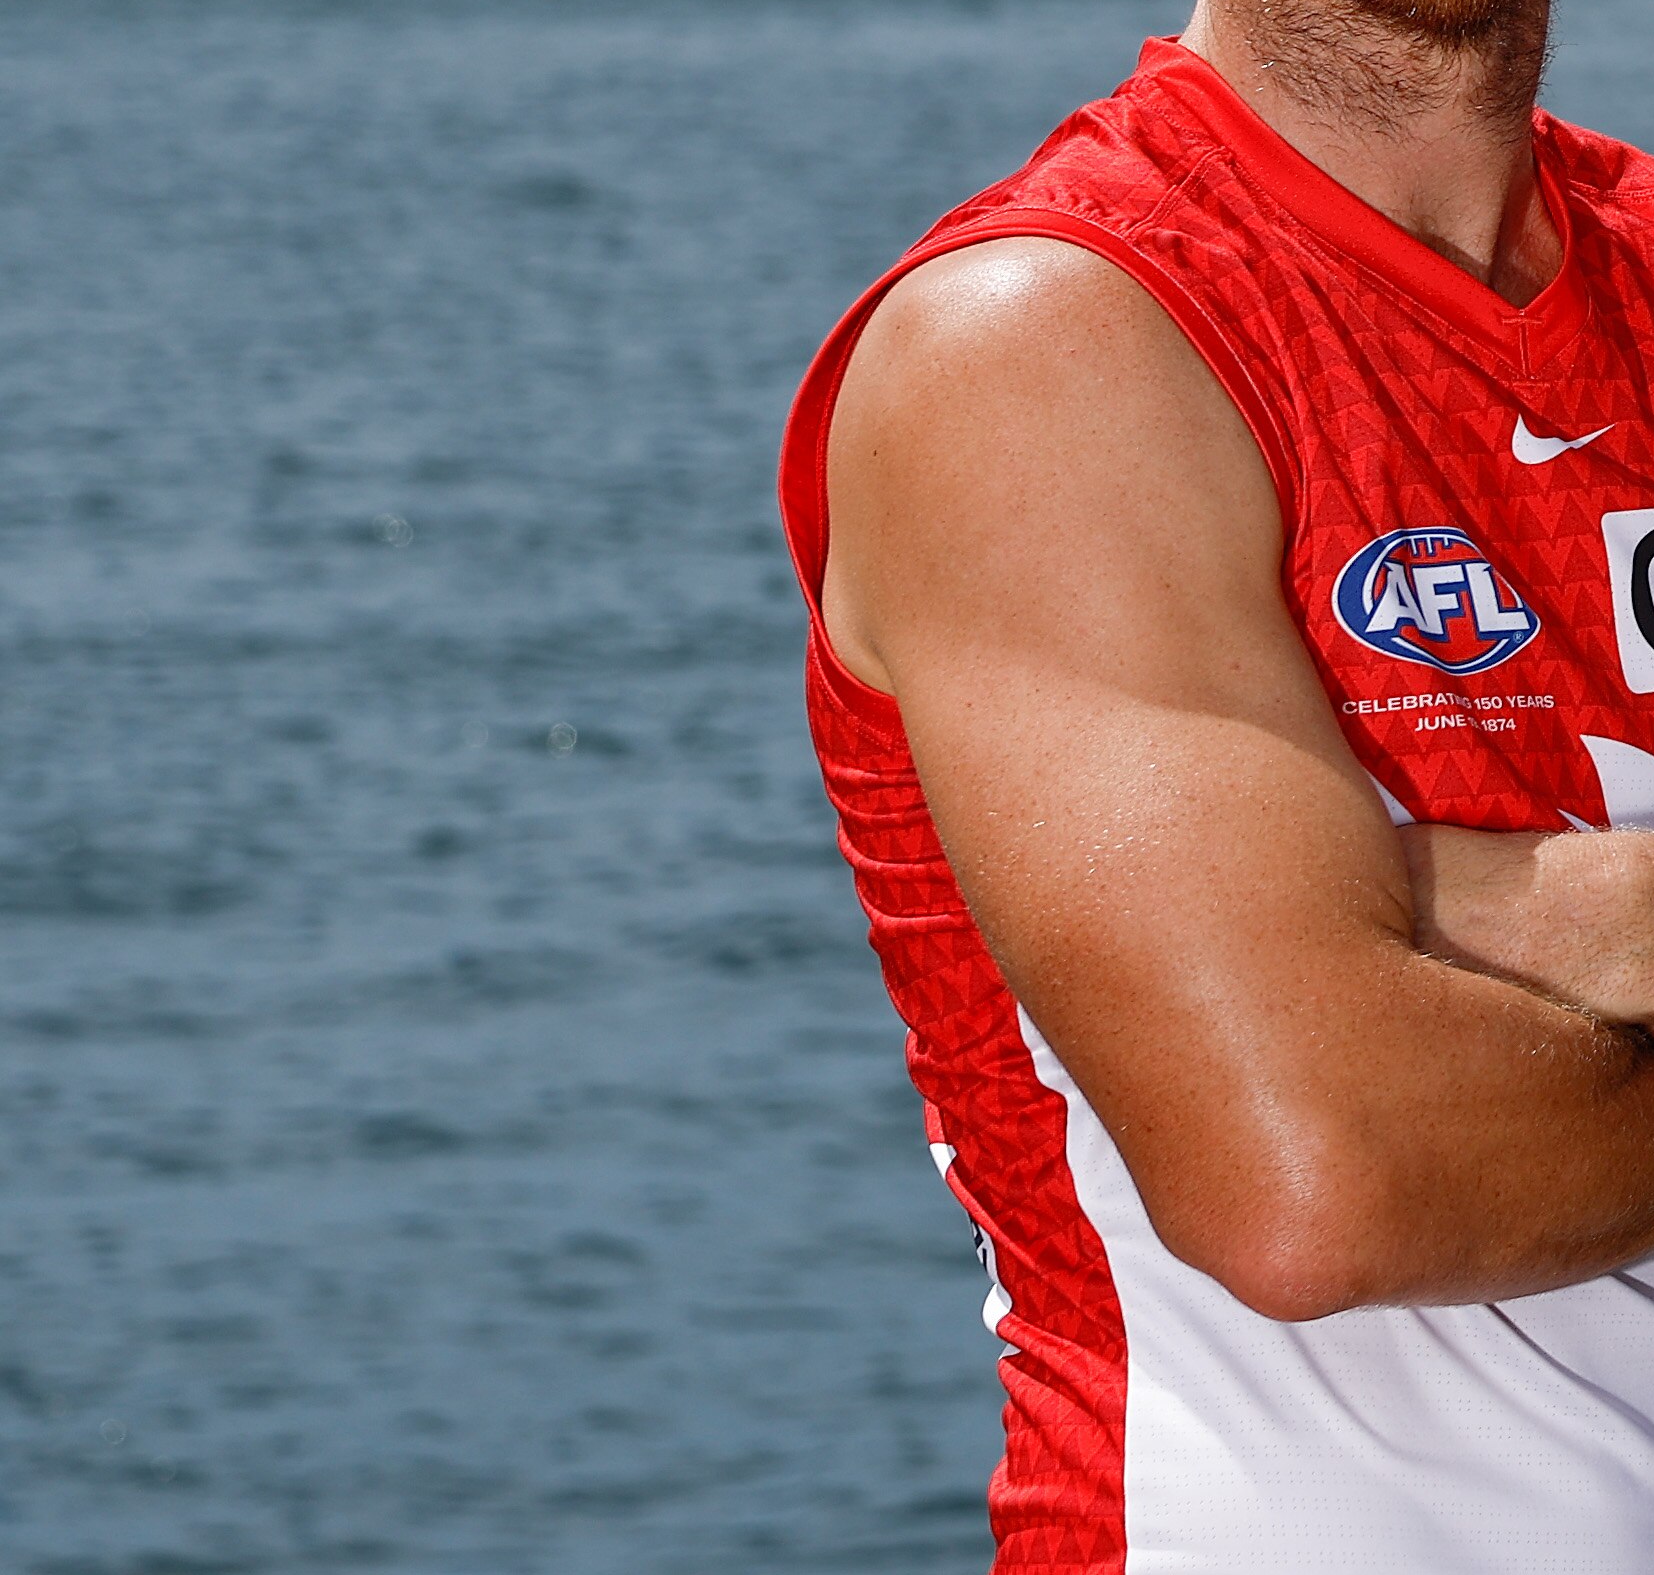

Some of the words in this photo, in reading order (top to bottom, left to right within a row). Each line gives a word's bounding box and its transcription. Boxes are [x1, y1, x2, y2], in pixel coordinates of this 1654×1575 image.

[1365, 561, 1530, 635] AFL
[1342, 693, 1472, 714] CELEBRATG
[1474, 695, 1503, 710] 150
[1505, 695, 1555, 709] YEARS
[1415, 714, 1468, 732] JUNE
[1481, 718, 1517, 732] 1874
